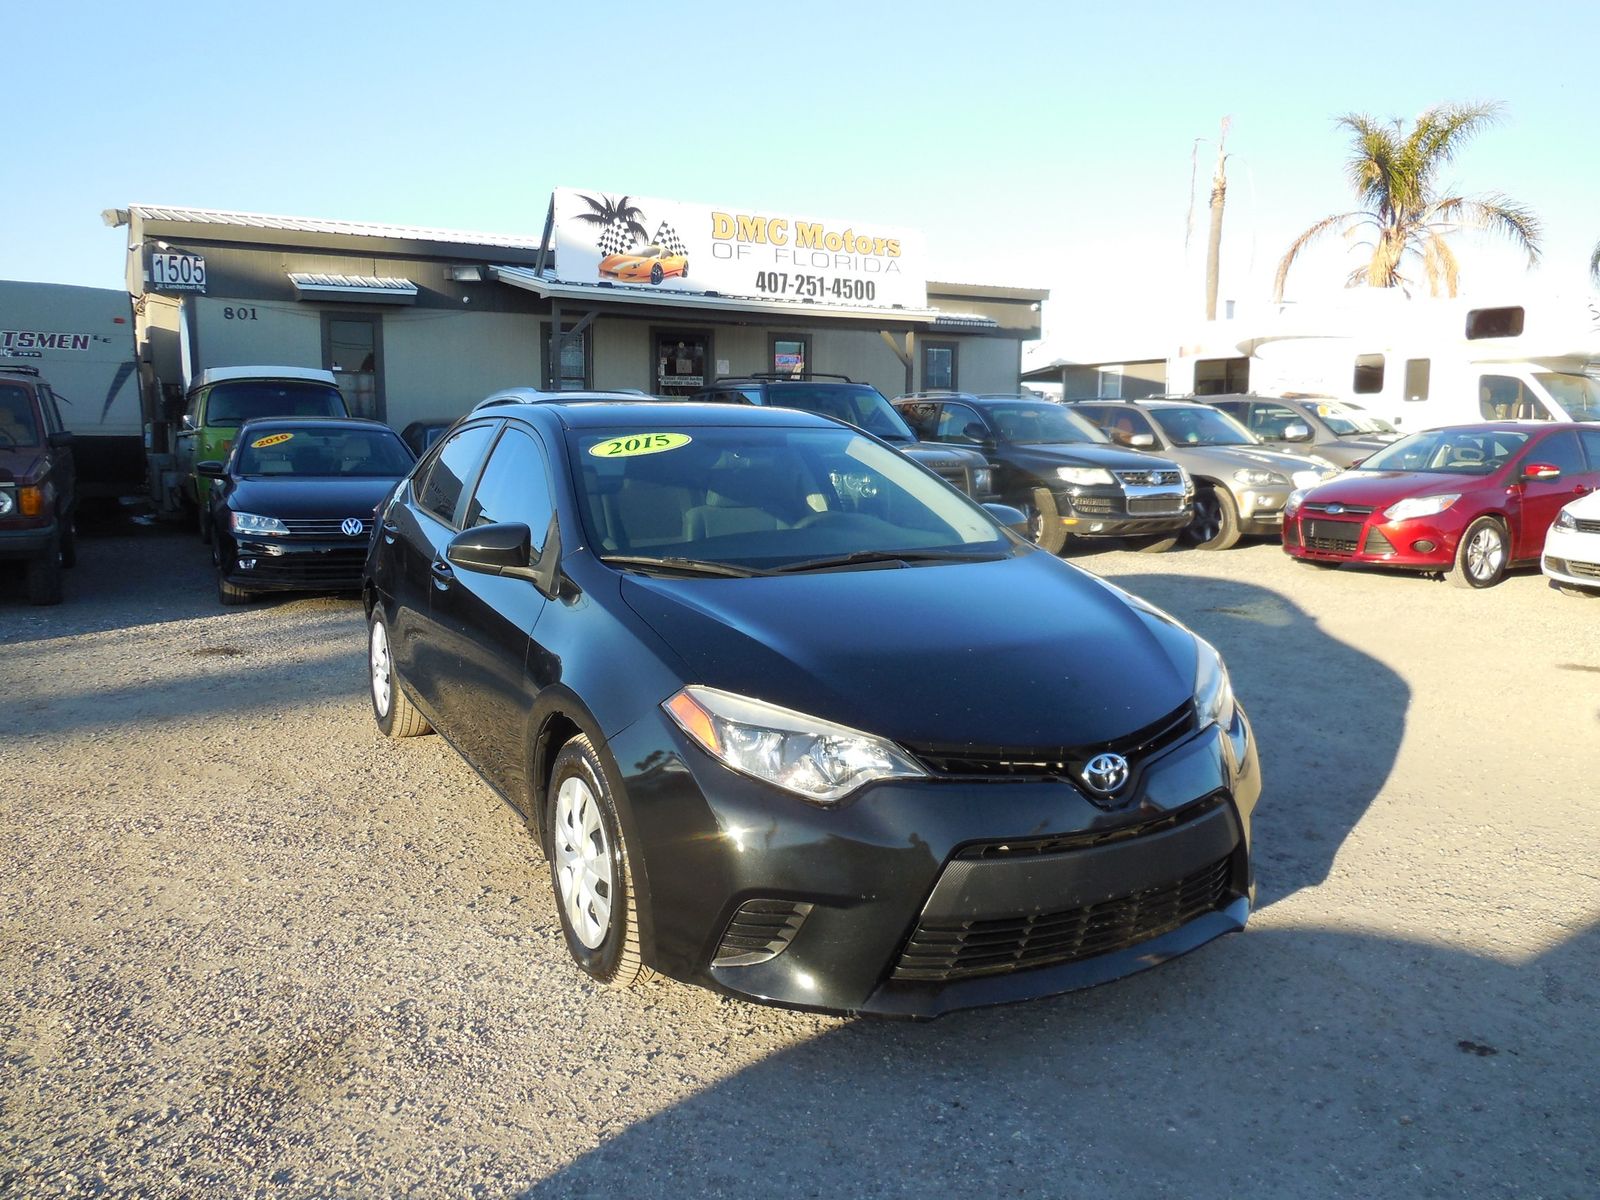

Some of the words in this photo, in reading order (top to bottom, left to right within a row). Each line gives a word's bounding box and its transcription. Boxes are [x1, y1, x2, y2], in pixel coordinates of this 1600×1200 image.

[711, 212, 788, 246] DMC
[795, 221, 901, 257] Motors
[155, 256, 204, 283] 1505
[712, 243, 751, 260] OF
[775, 248, 901, 273] FLORIDA
[755, 271, 875, 301] 407-251-4500
[223, 307, 257, 320] 801
[608, 435, 670, 455] 2015
